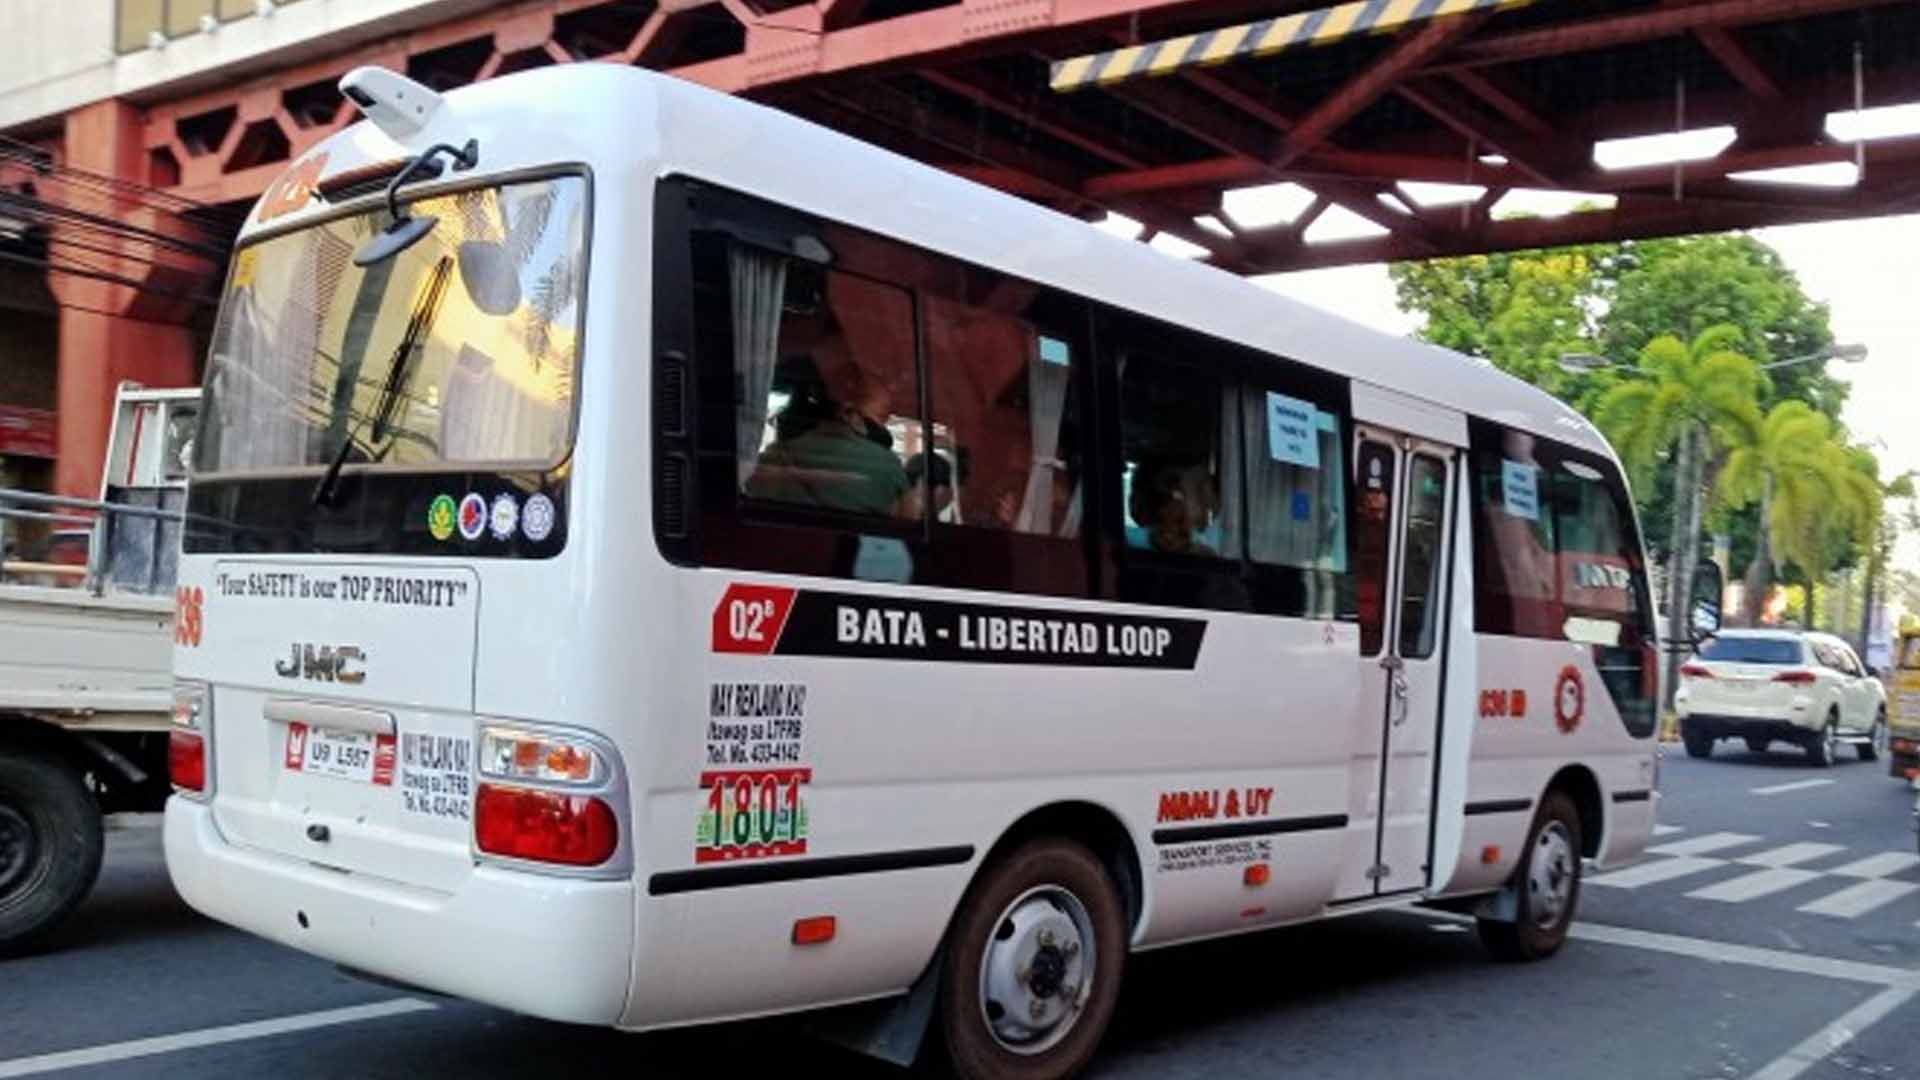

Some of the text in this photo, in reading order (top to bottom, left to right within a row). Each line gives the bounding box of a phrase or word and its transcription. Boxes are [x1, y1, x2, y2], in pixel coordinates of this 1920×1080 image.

[248, 572, 298, 598] SAFETY
[299, 574, 311, 598] is
[313, 581, 336, 599] our
[340, 575, 371, 601] TOP
[837, 606, 926, 646] BATA
[937, 628, 949, 638] -
[959, 615, 1099, 653] LIBERTAD
[1106, 624, 1171, 656] LOOP
[275, 643, 366, 683] JMC
[710, 684, 734, 717] MAY
[735, 684, 783, 717] REKLAMO
[751, 724, 763, 740] sa
[767, 720, 801, 739] LTFRB
[707, 744, 727, 763] Tel.
[708, 776, 799, 849] 1801
[1224, 788, 1240, 818] &
[1245, 787, 1274, 816] UY
